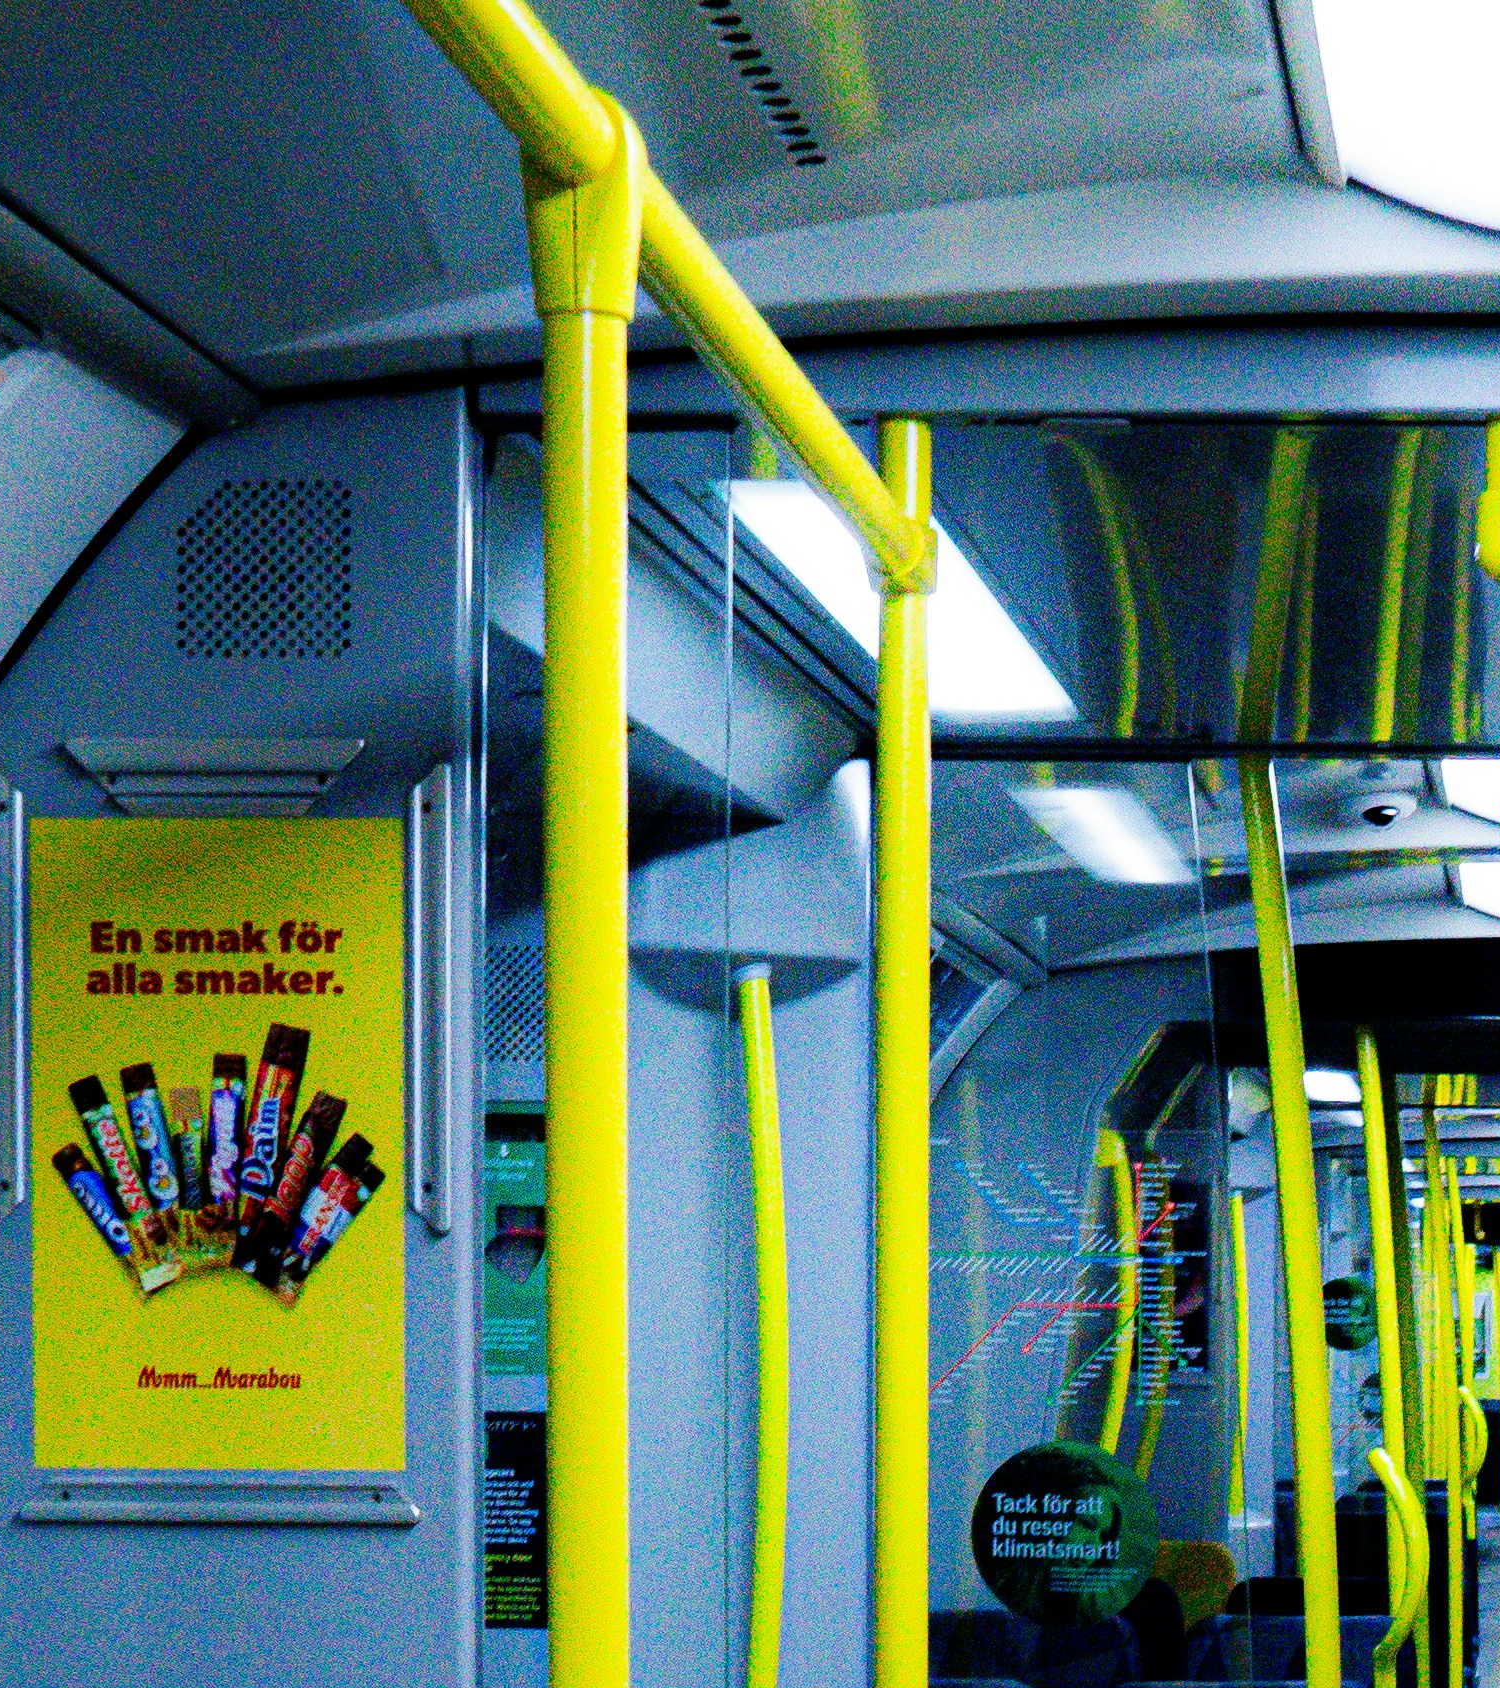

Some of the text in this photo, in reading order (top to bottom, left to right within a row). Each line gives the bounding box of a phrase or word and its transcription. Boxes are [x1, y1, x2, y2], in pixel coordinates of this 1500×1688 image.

[89, 919, 343, 953] En smak för
[86, 963, 345, 996] alla smaker.
[240, 1096, 281, 1201] Daim
[991, 1492, 1104, 1515] Tack för att
[991, 1514, 1073, 1537] du reser
[991, 1537, 1121, 1560] klimatsmart!
